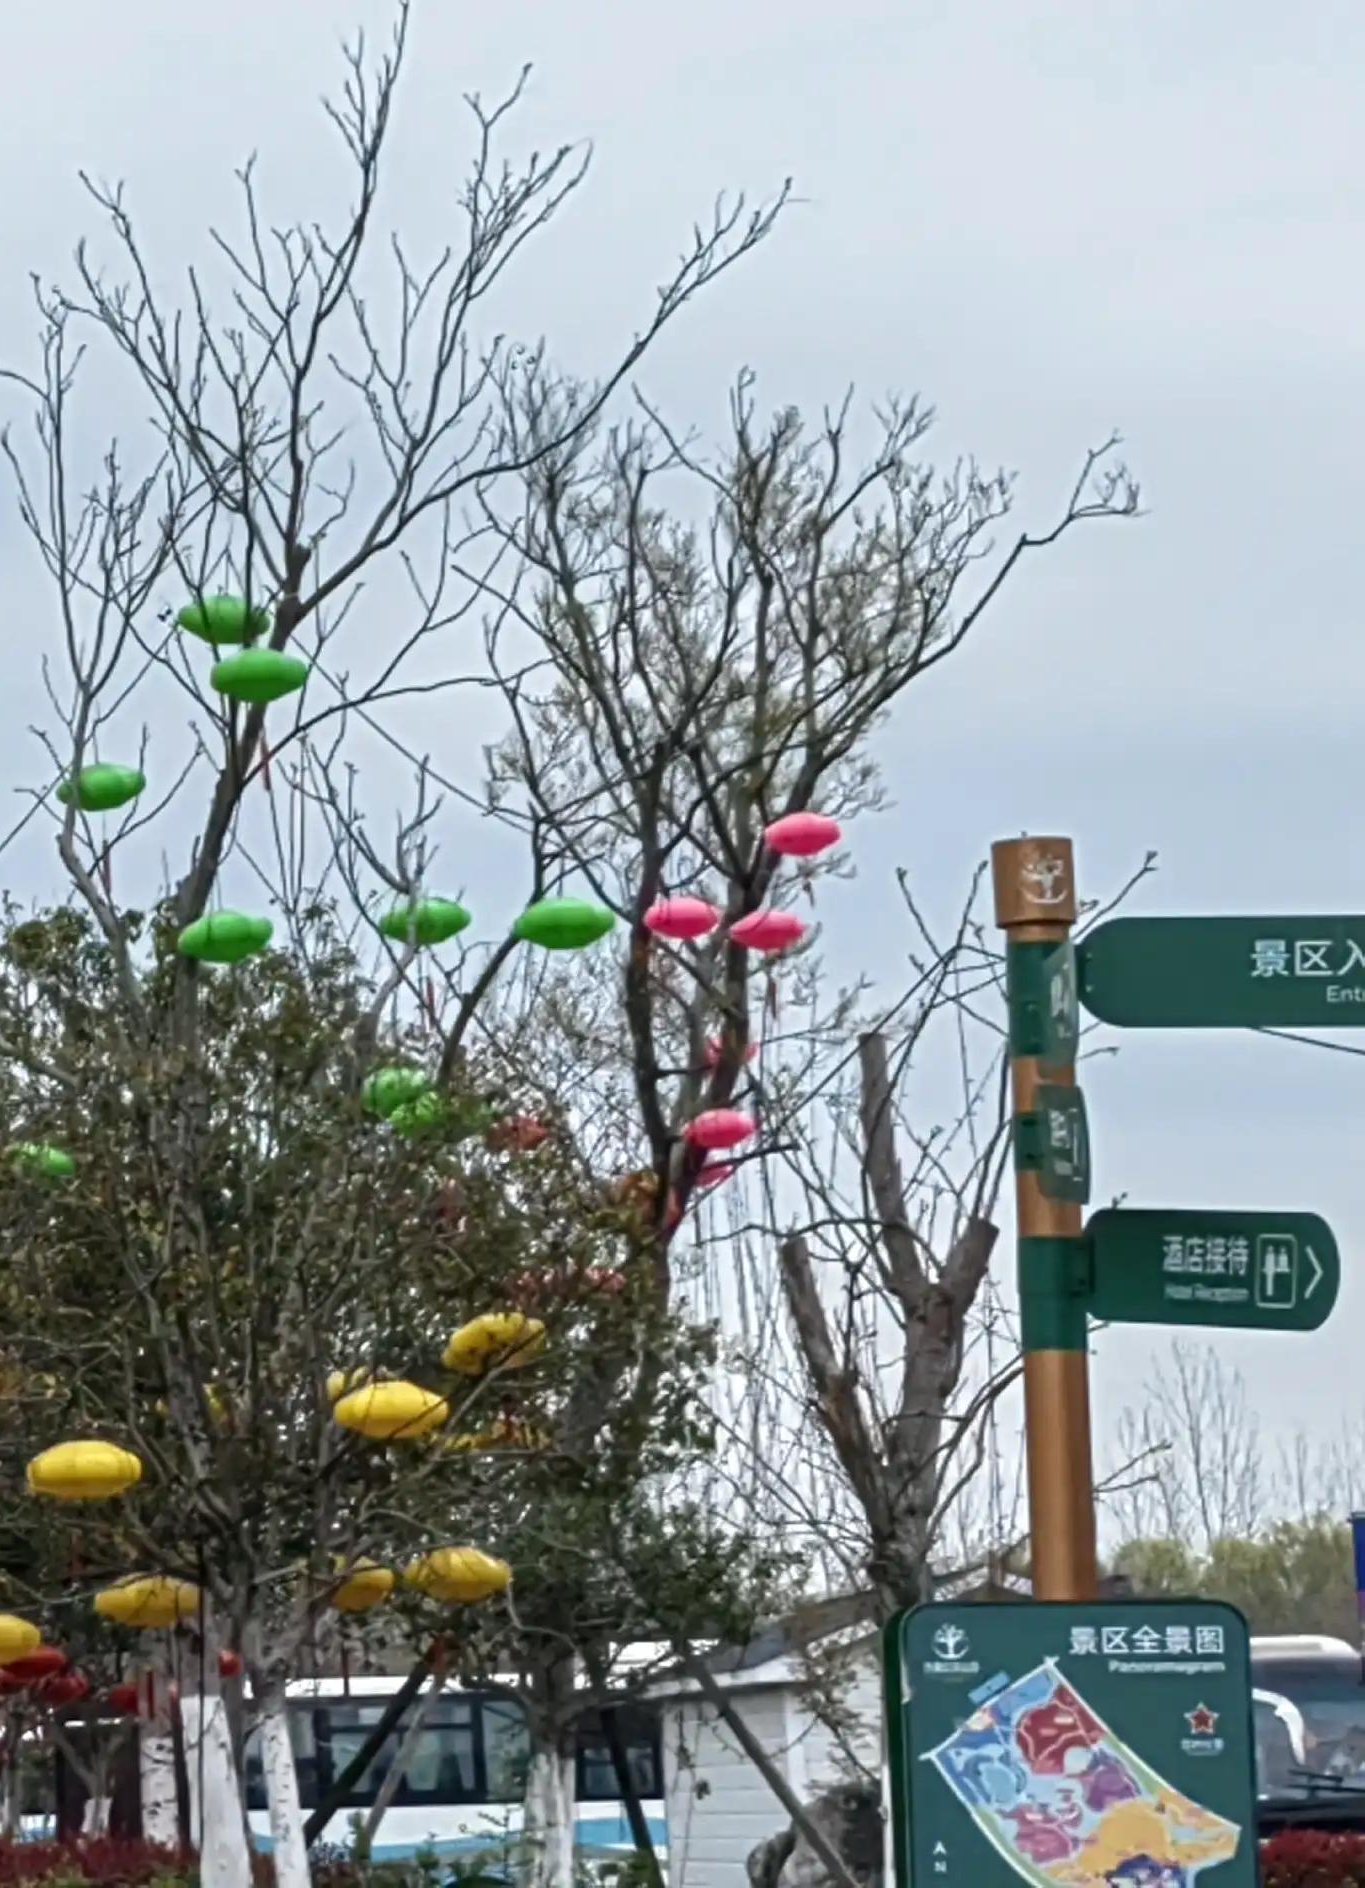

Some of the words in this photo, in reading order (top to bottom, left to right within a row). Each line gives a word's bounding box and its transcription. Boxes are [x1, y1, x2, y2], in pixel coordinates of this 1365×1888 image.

[1326, 985, 1365, 1003] Ent
[1163, 1235, 1248, 1275] 酒店接待
[1070, 1625, 1224, 1655] 景区全景图
